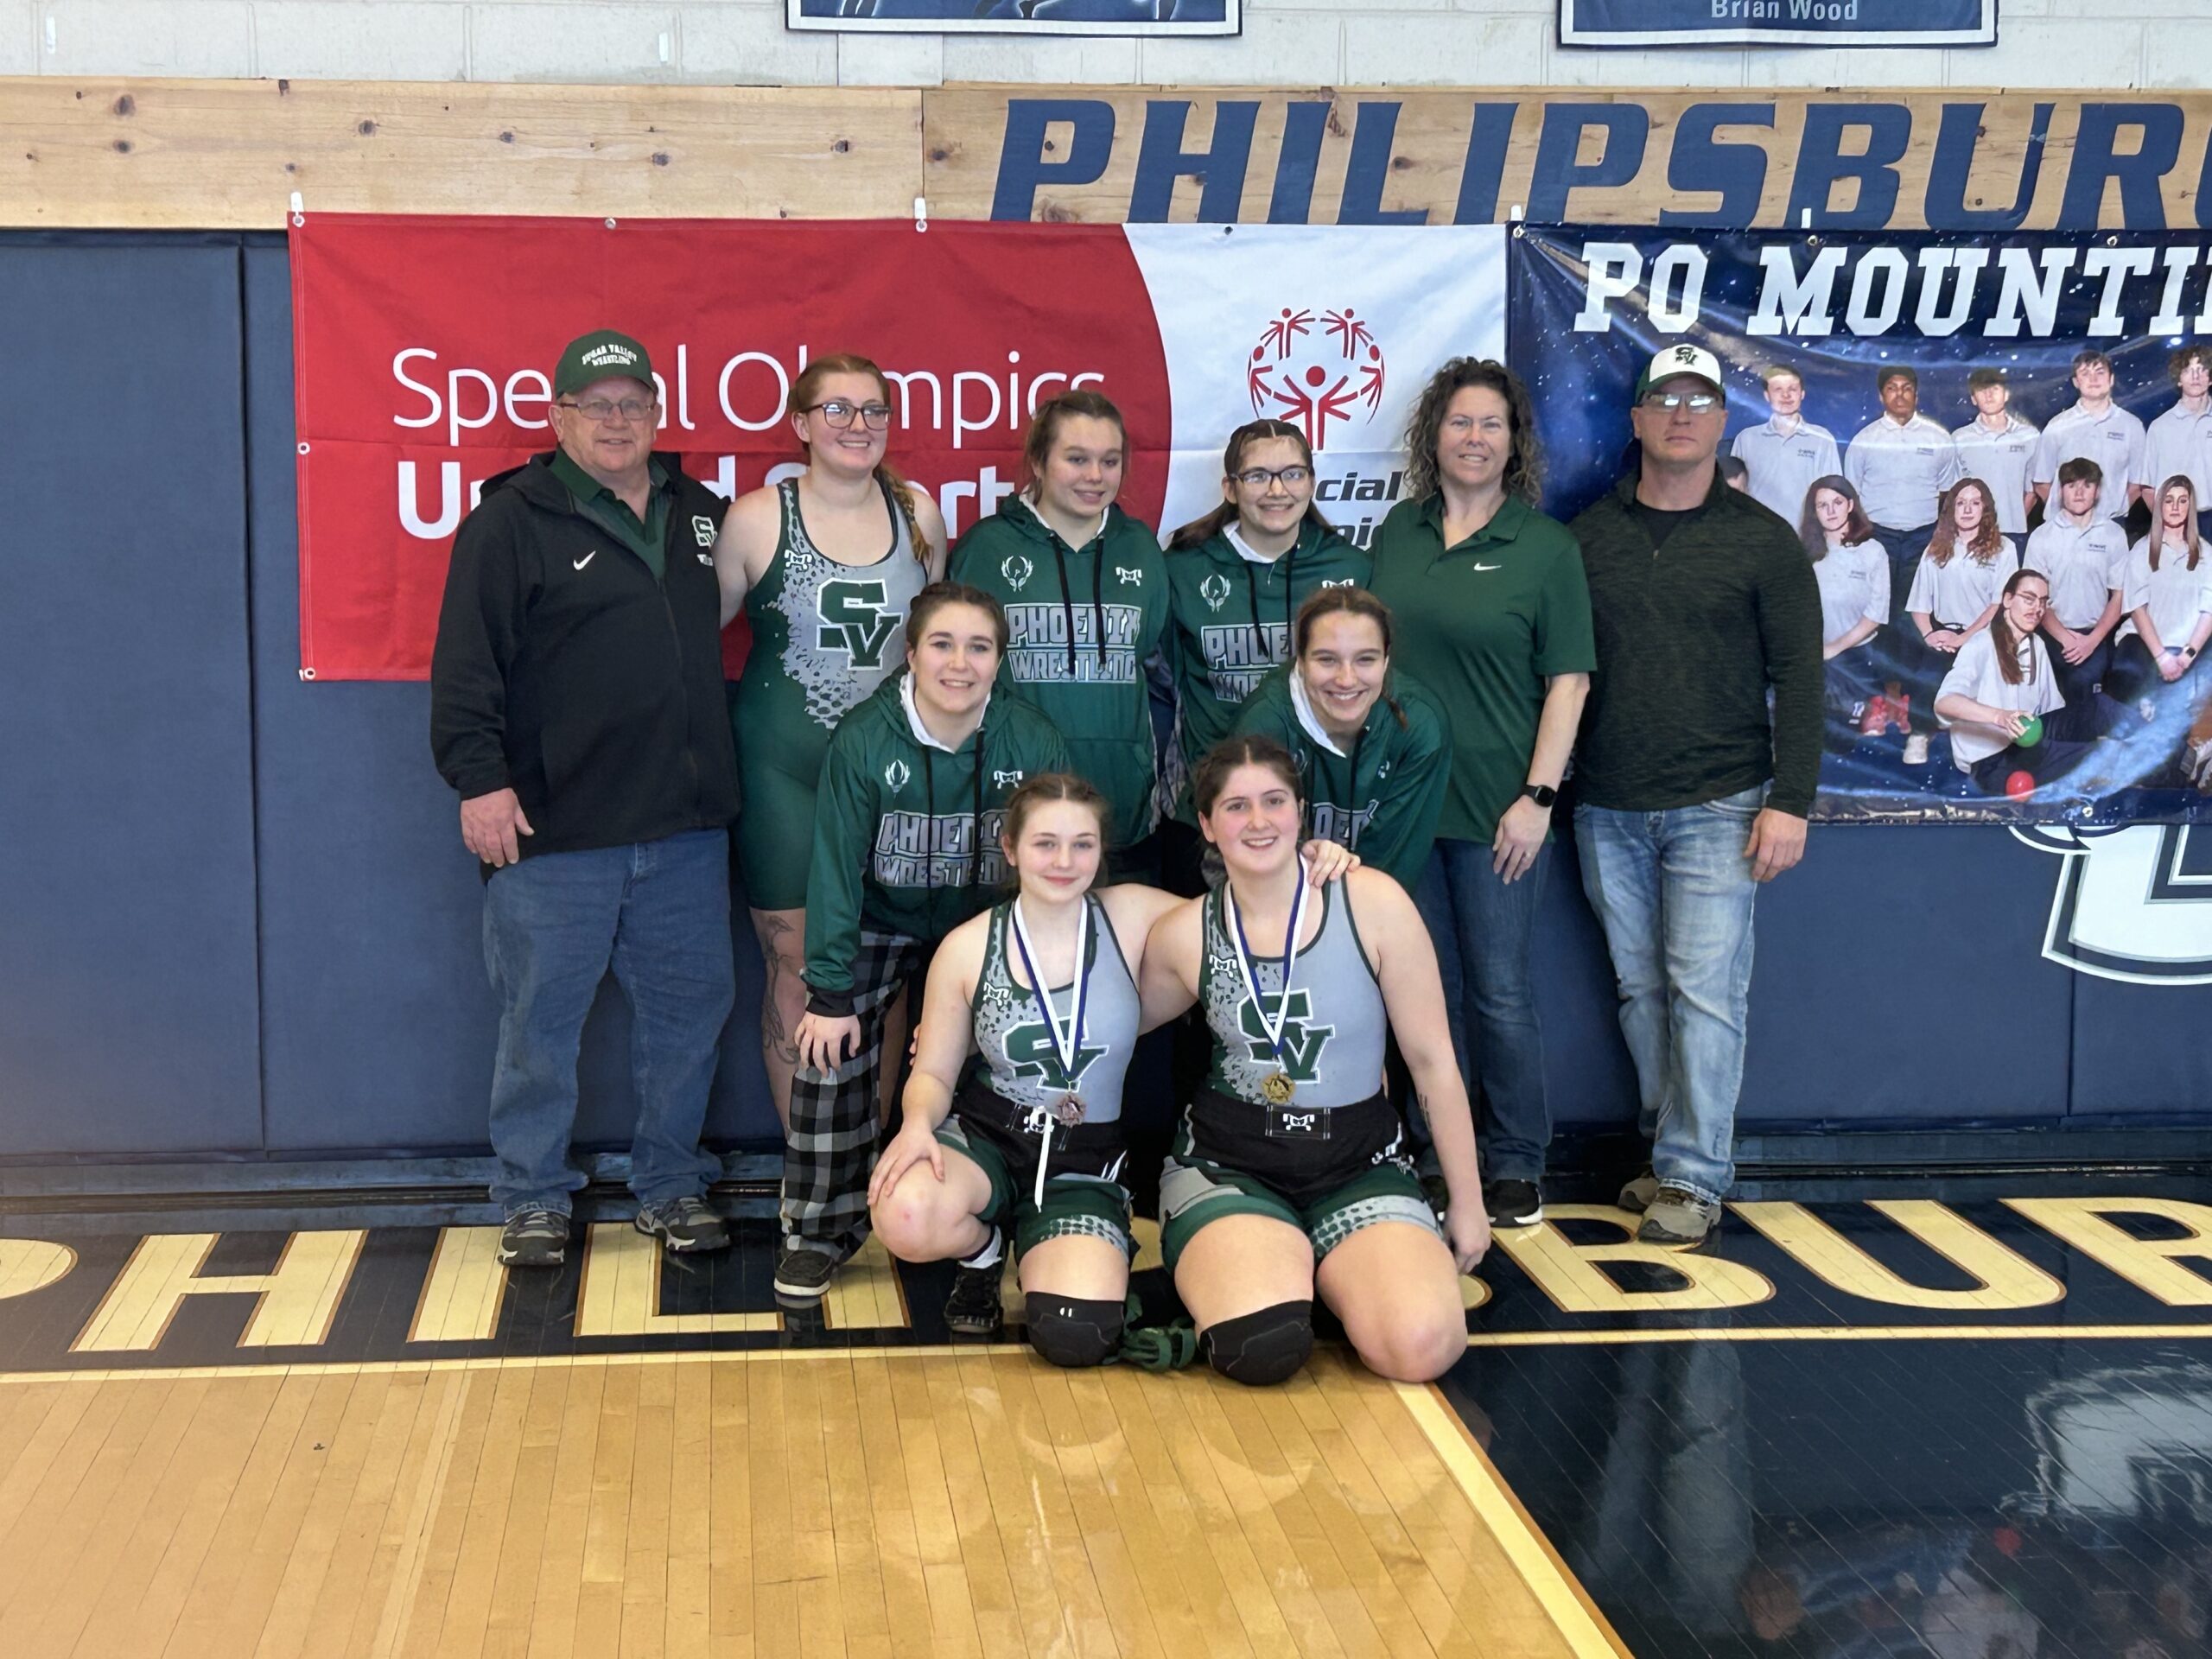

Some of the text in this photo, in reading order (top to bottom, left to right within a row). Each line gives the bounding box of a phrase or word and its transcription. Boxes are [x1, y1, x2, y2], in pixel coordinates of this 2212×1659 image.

[1711, 0, 1858, 21] Brian Wood
[990, 99, 2212, 233] PHILIPSBUR
[1573, 241, 1708, 334] PO
